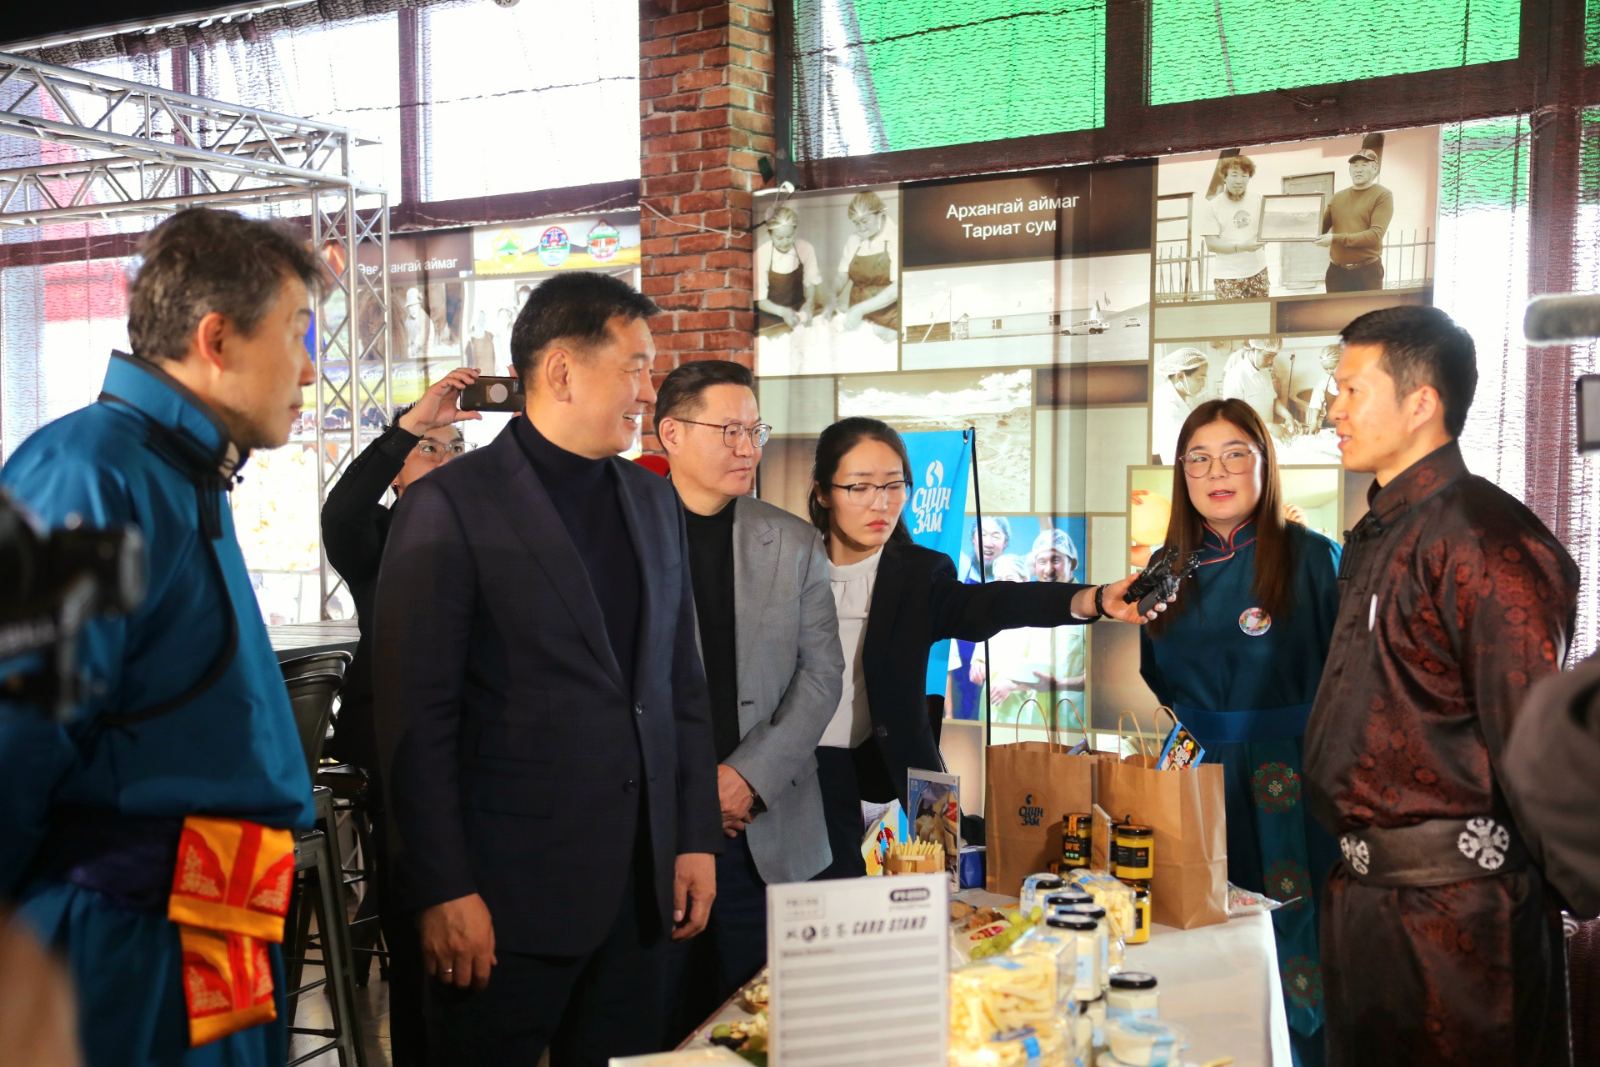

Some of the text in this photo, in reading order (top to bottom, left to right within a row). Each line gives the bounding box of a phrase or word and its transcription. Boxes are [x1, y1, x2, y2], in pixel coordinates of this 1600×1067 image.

[946, 196, 1080, 221] Архангай аймаг
[962, 220, 1056, 240] Тариат сум
[424, 257, 458, 271] аймаг
